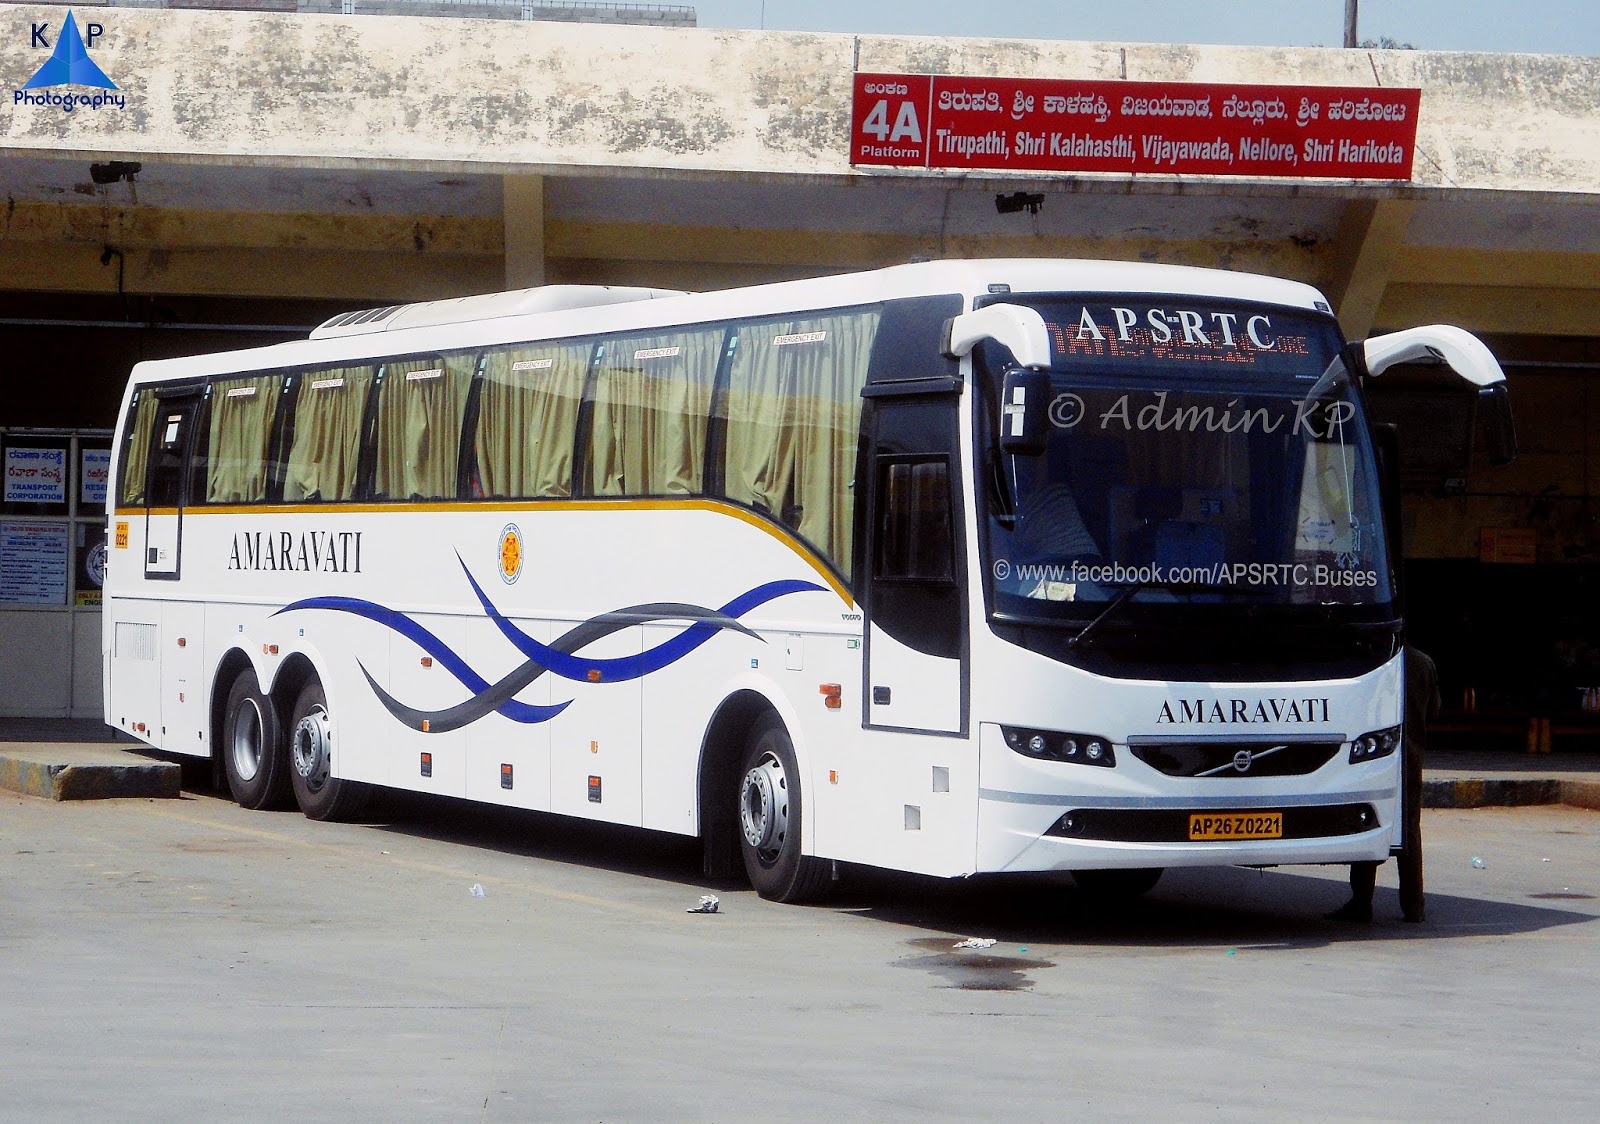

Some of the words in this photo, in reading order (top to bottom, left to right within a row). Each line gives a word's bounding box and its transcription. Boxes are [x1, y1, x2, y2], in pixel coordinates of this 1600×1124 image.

[864, 82, 908, 95] ಅಂಕಣ
[938, 90, 1003, 114] ತಿರುಪತಿ,
[1011, 90, 1035, 120] ಶ್ರೀ
[1296, 97, 1320, 126] ಶ್ರೀ
[862, 99, 922, 143] 4A
[861, 145, 919, 158] Platform
[936, 129, 1009, 159] Tirupathi,
[1014, 132, 1046, 156] Shri
[1050, 133, 1136, 163] Kalahasthi,
[1142, 135, 1234, 165] Vijayawada,
[1239, 138, 1298, 166] Nellore,
[1303, 139, 1334, 162] Shri
[1338, 140, 1404, 164] Harikota
[776, 335, 809, 344] EMERGENCY
[7, 492, 63, 500] CORPORATION
[11, 483, 58, 491] TRANSPORT
[228, 531, 363, 573] AMARAVATI
[1156, 698, 1330, 724] AMARAVATI
[1191, 816, 1281, 836] AP26Z0221
